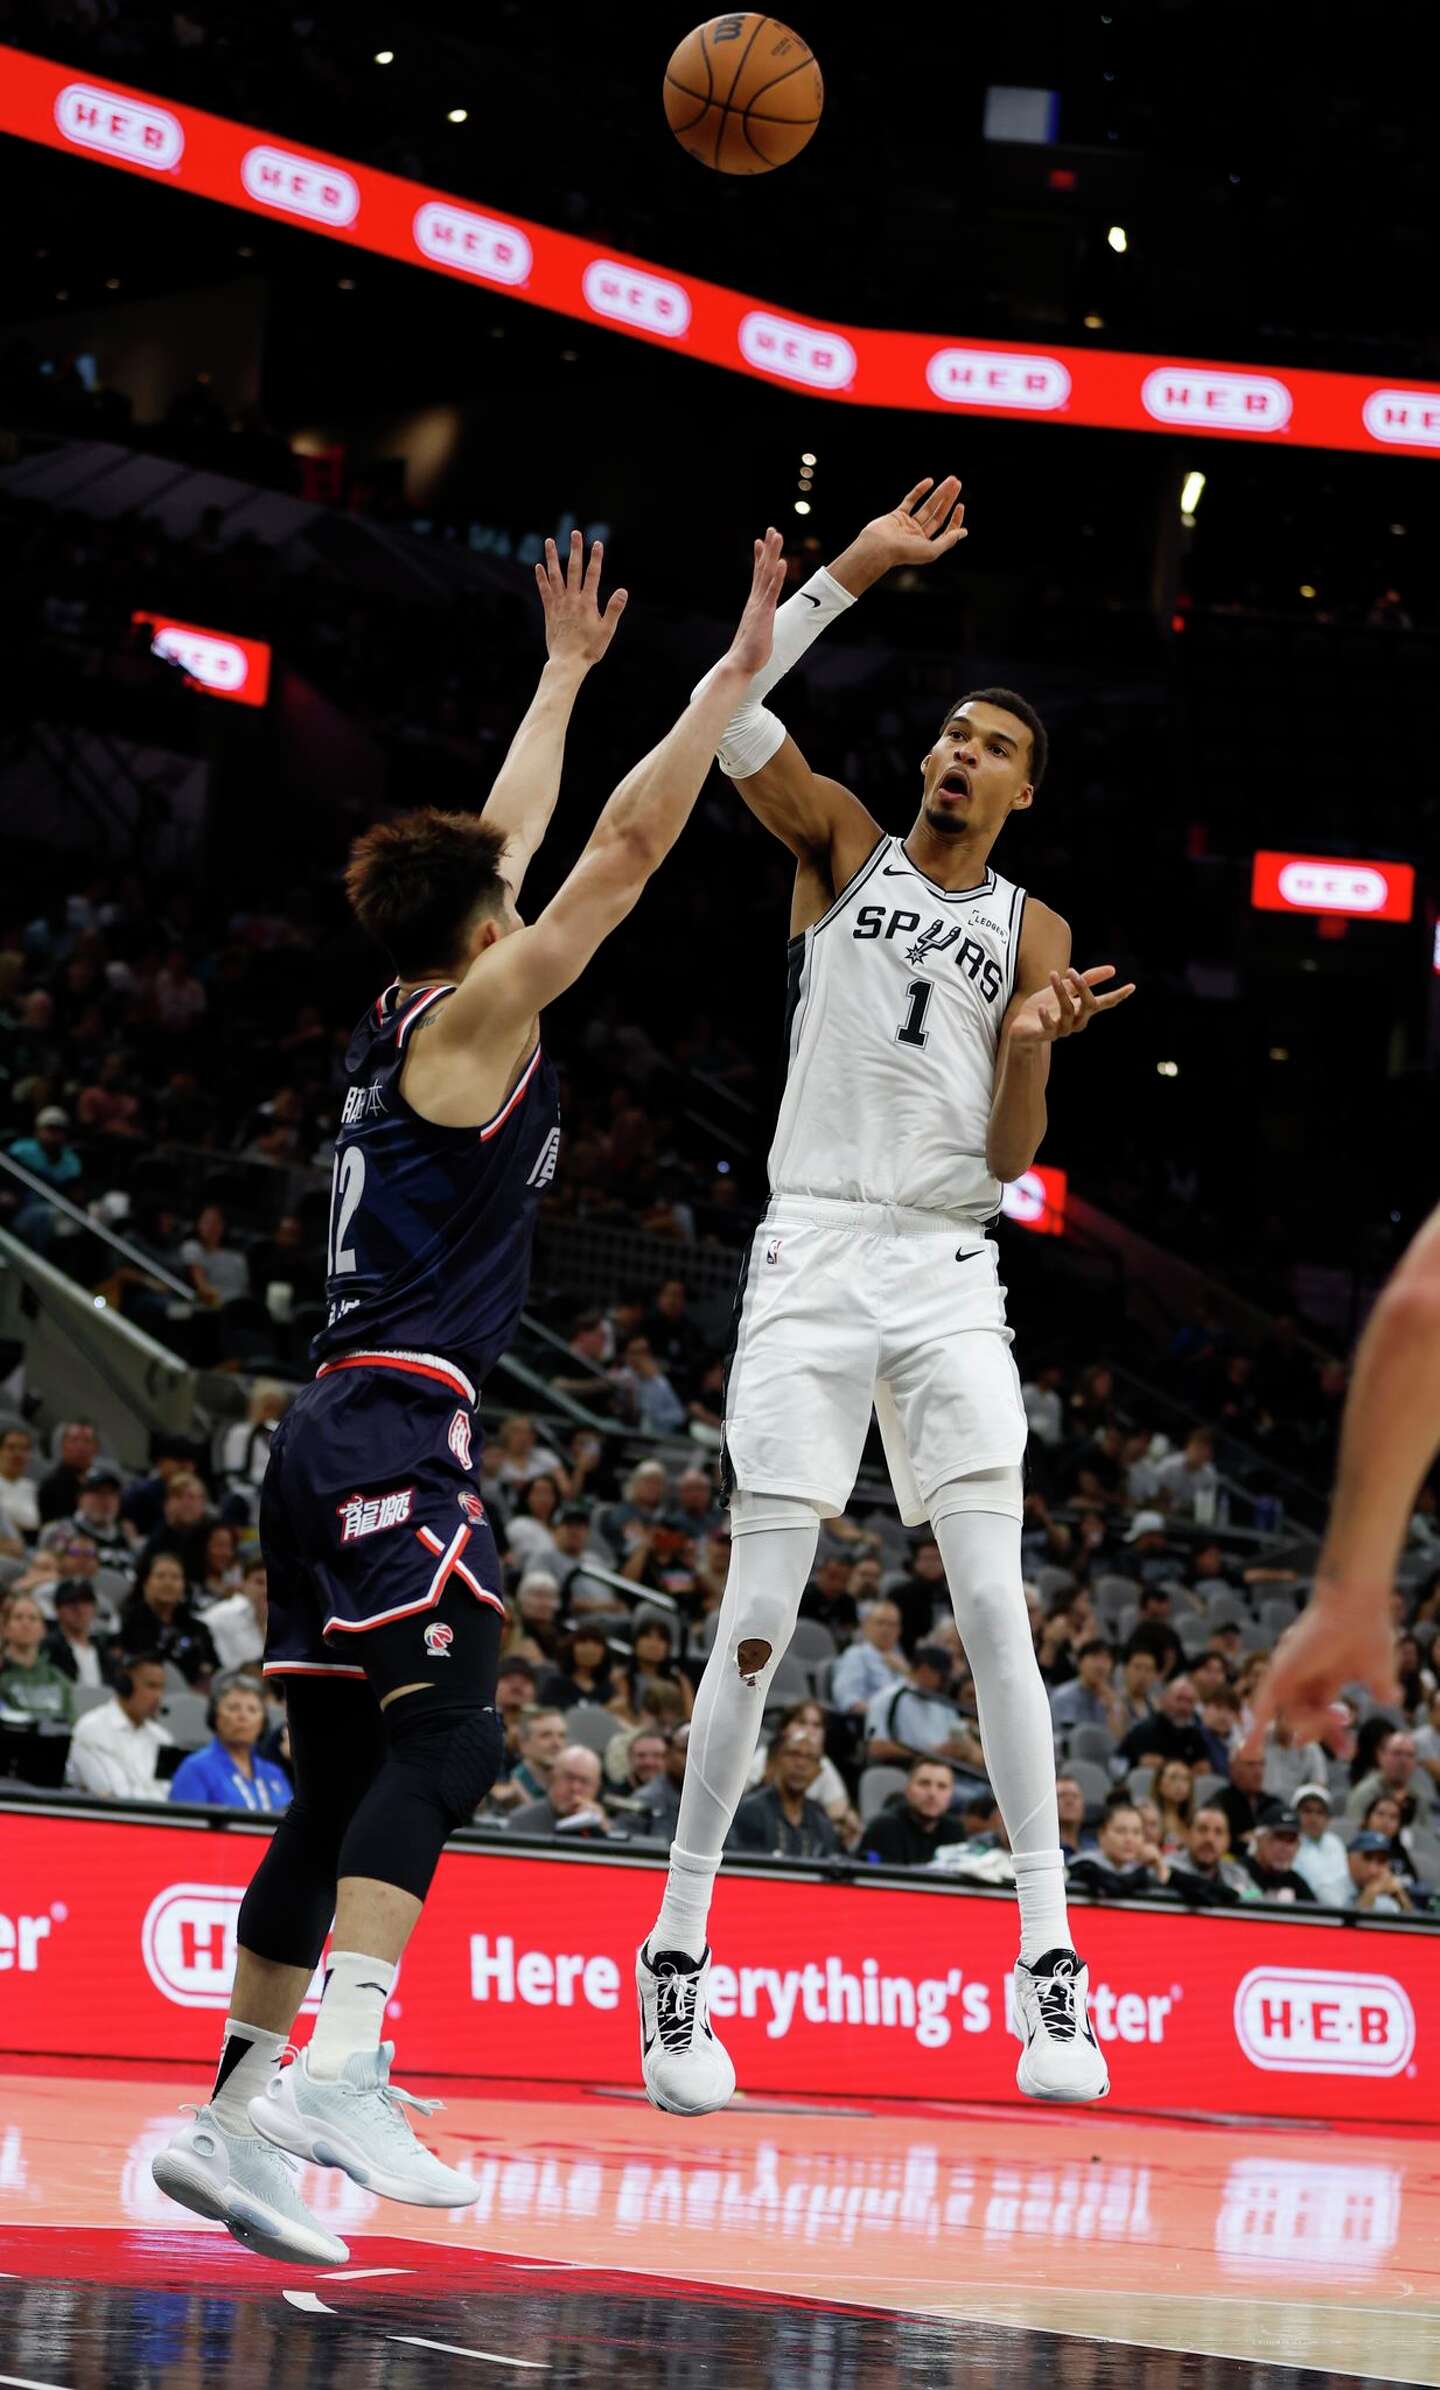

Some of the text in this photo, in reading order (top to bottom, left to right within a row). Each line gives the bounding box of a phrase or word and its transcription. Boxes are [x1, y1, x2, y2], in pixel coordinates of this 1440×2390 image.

[852, 905, 1004, 1004] SPURS
[895, 978, 935, 1050] 1
[469, 1933, 621, 2011] Here
[706, 1955, 992, 2049] erything's
